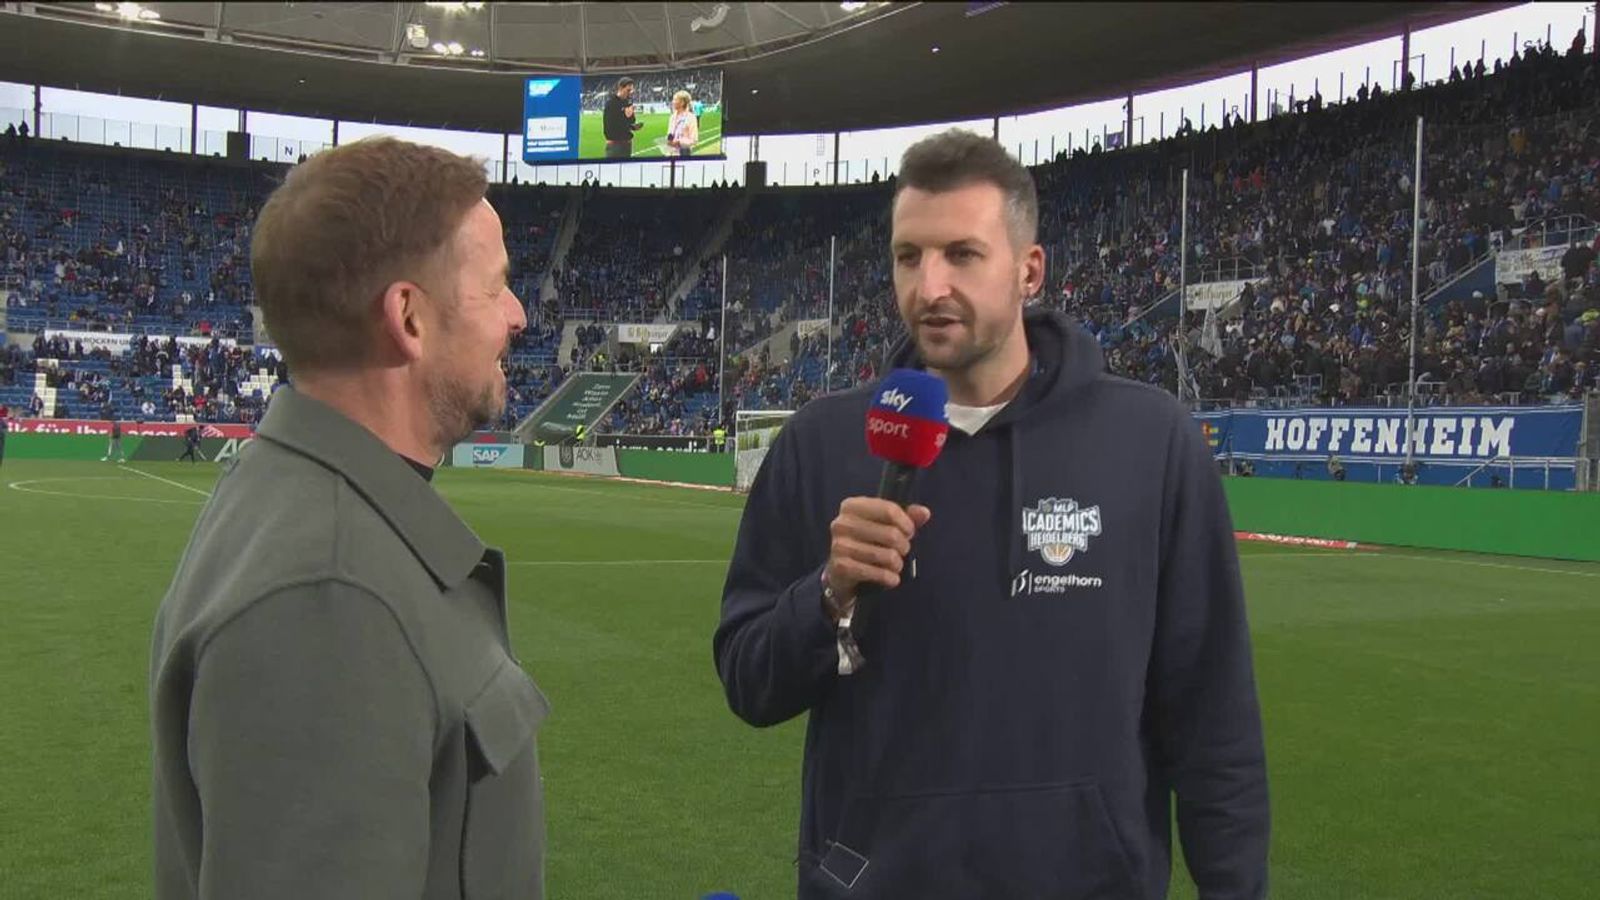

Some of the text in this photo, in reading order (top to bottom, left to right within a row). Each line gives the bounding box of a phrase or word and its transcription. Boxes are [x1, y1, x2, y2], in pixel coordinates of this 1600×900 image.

[284, 146, 293, 156] N
[880, 386, 914, 412] sky
[867, 417, 910, 438] sport
[1265, 416, 1515, 457] HOFFENHEIM
[473, 450, 501, 462] SAP
[576, 446, 594, 461] AOK
[1033, 573, 1102, 587] engelhorn
